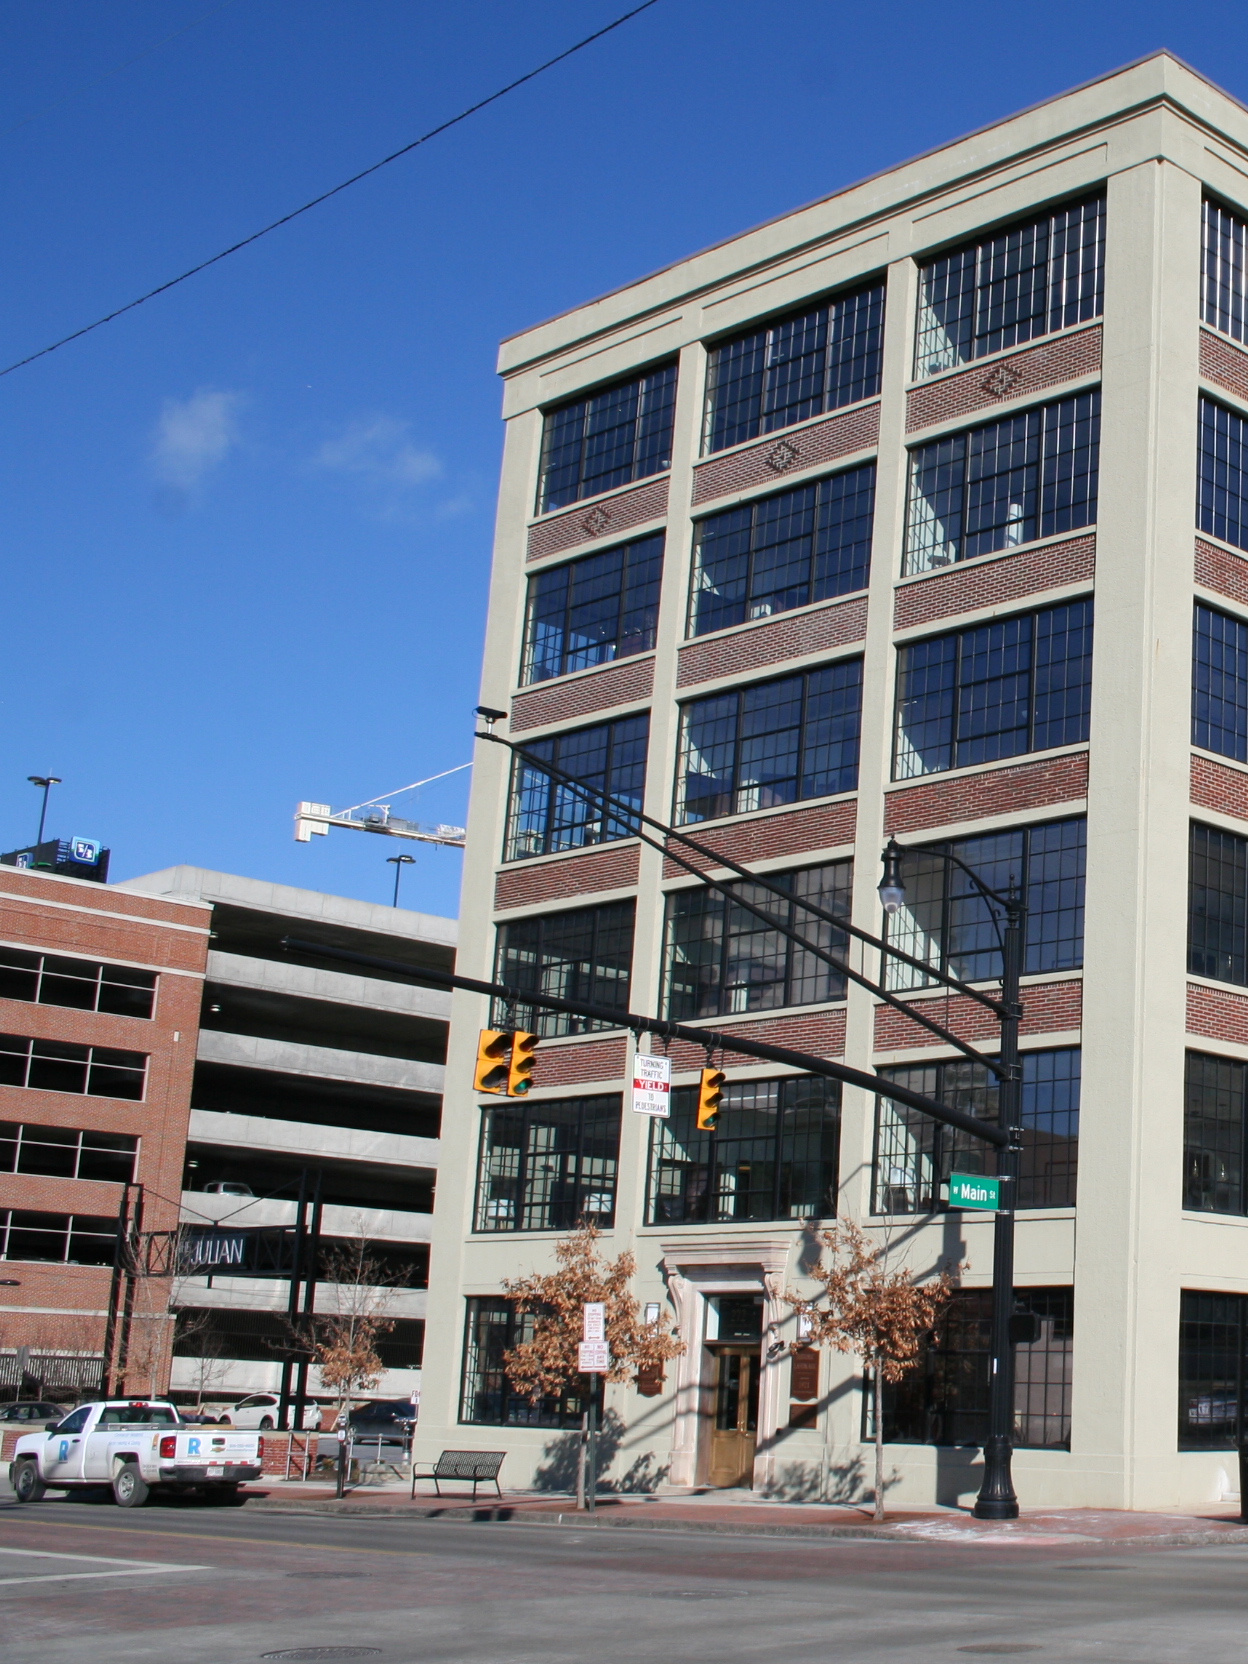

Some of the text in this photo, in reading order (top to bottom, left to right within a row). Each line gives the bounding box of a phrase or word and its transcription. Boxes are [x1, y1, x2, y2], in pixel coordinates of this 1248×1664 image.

[640, 1059, 664, 1069] TURNING
[641, 1069, 662, 1079] TRAFFIC
[640, 1080, 664, 1091] YIELD
[648, 1093, 654, 1101] TO
[635, 1101, 667, 1113] PEDESTRIANS
[953, 1183, 996, 1202] W Main St
[190, 1238, 243, 1264] JULIAN
[59, 1440, 69, 1461] R
[187, 1437, 202, 1455] R
